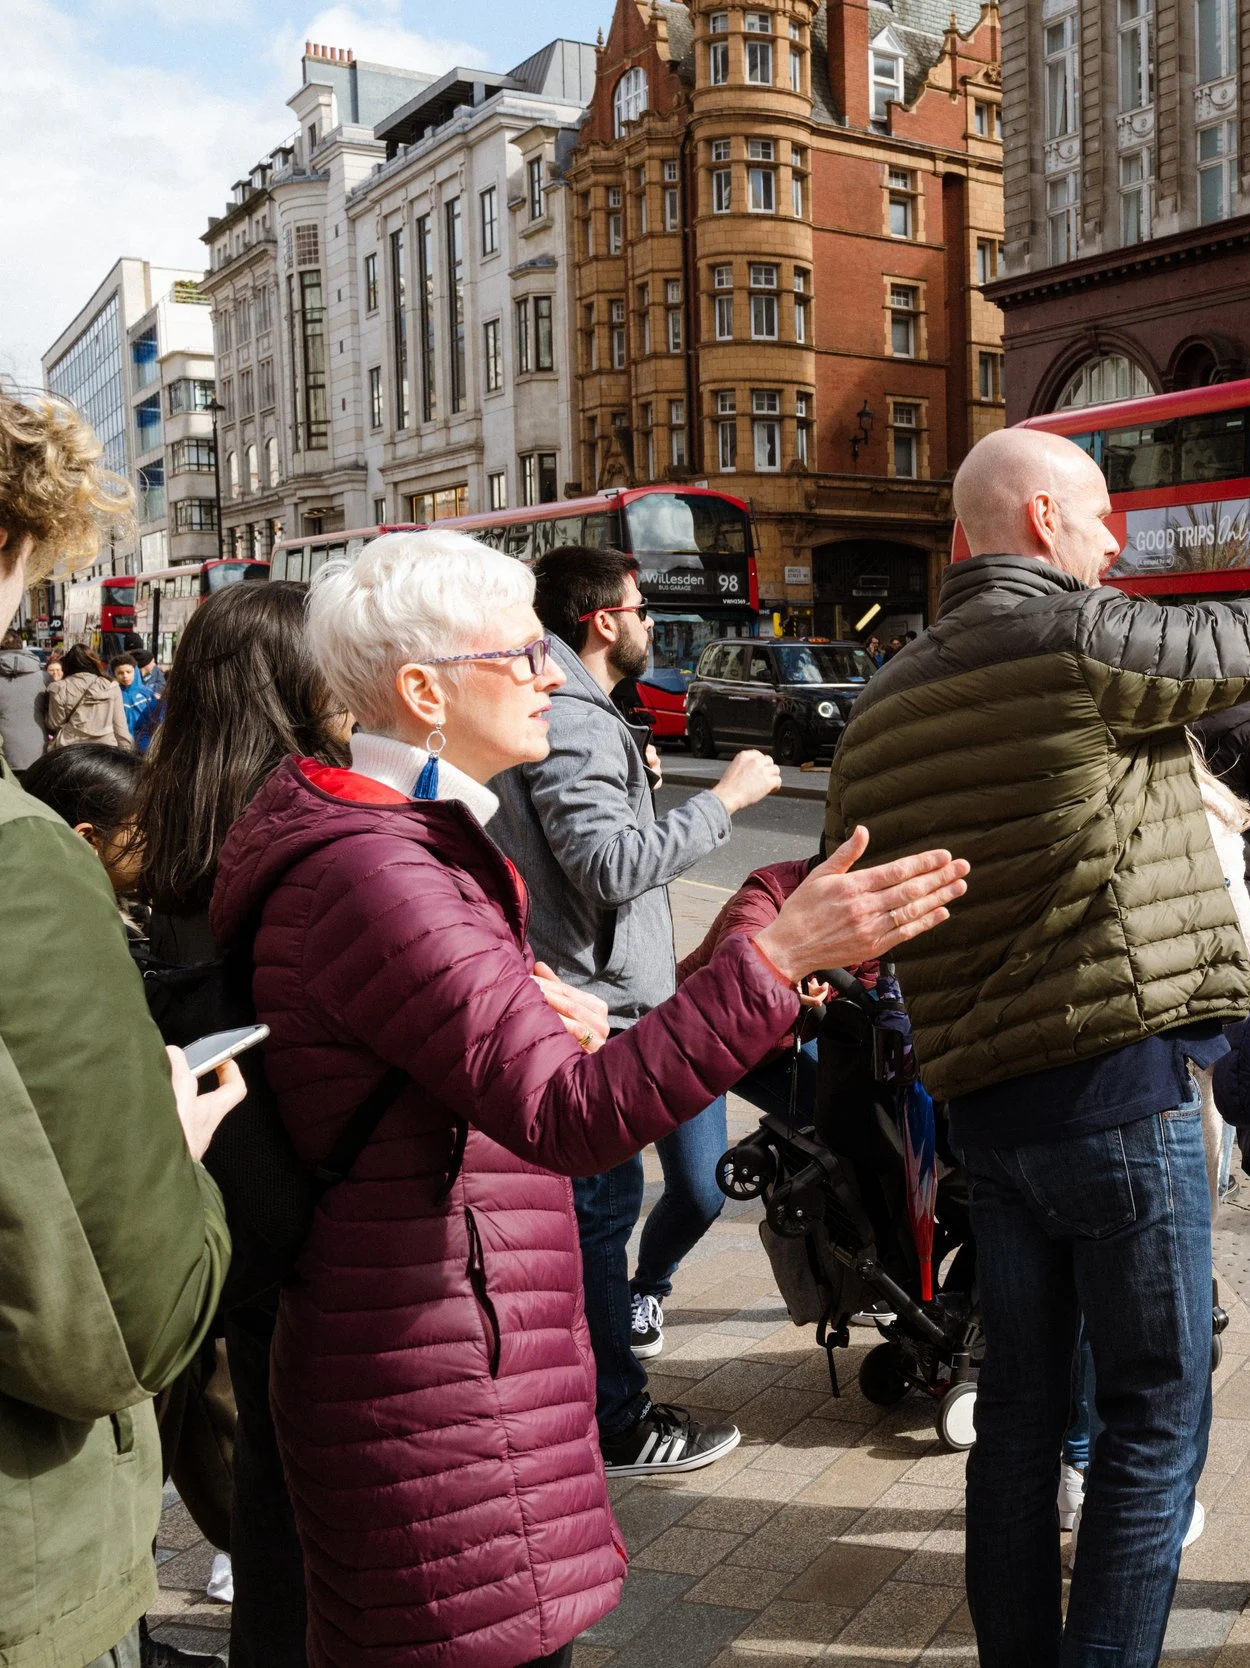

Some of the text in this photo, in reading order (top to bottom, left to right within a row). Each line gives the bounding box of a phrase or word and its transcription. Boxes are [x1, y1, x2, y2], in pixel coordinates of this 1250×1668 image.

[1136, 527, 1175, 552] GOOD
[1178, 524, 1215, 548] TRIPS
[645, 573, 739, 592] Willesden 98
